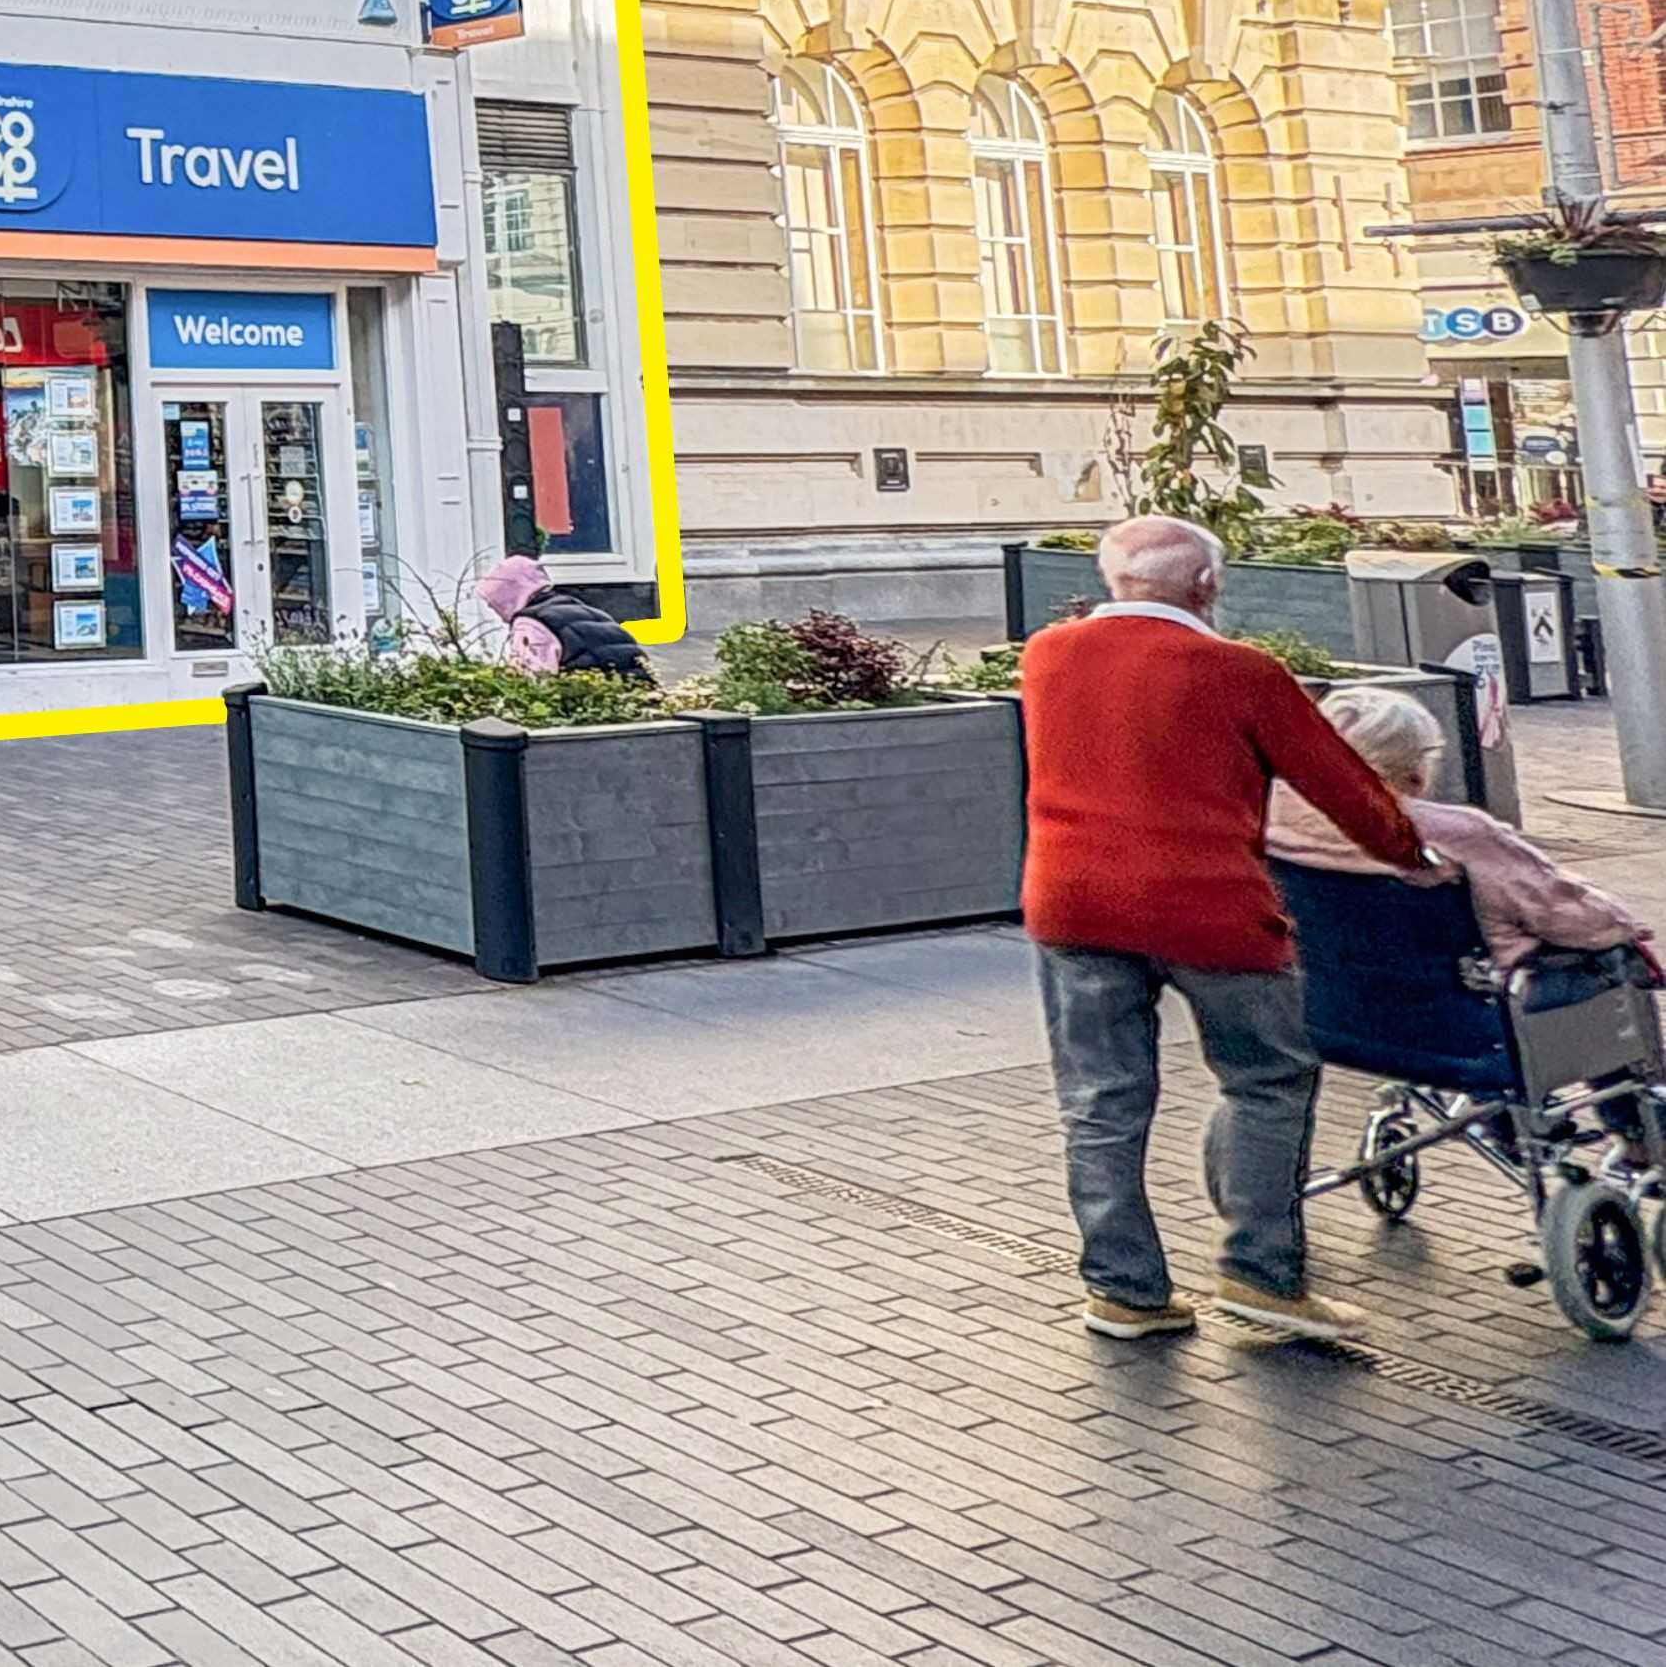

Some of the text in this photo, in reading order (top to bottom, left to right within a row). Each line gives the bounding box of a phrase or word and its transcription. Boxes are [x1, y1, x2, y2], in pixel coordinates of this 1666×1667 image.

[125, 127, 300, 191] Travel
[173, 314, 305, 347] Welcome
[1424, 312, 1516, 332] TSB
